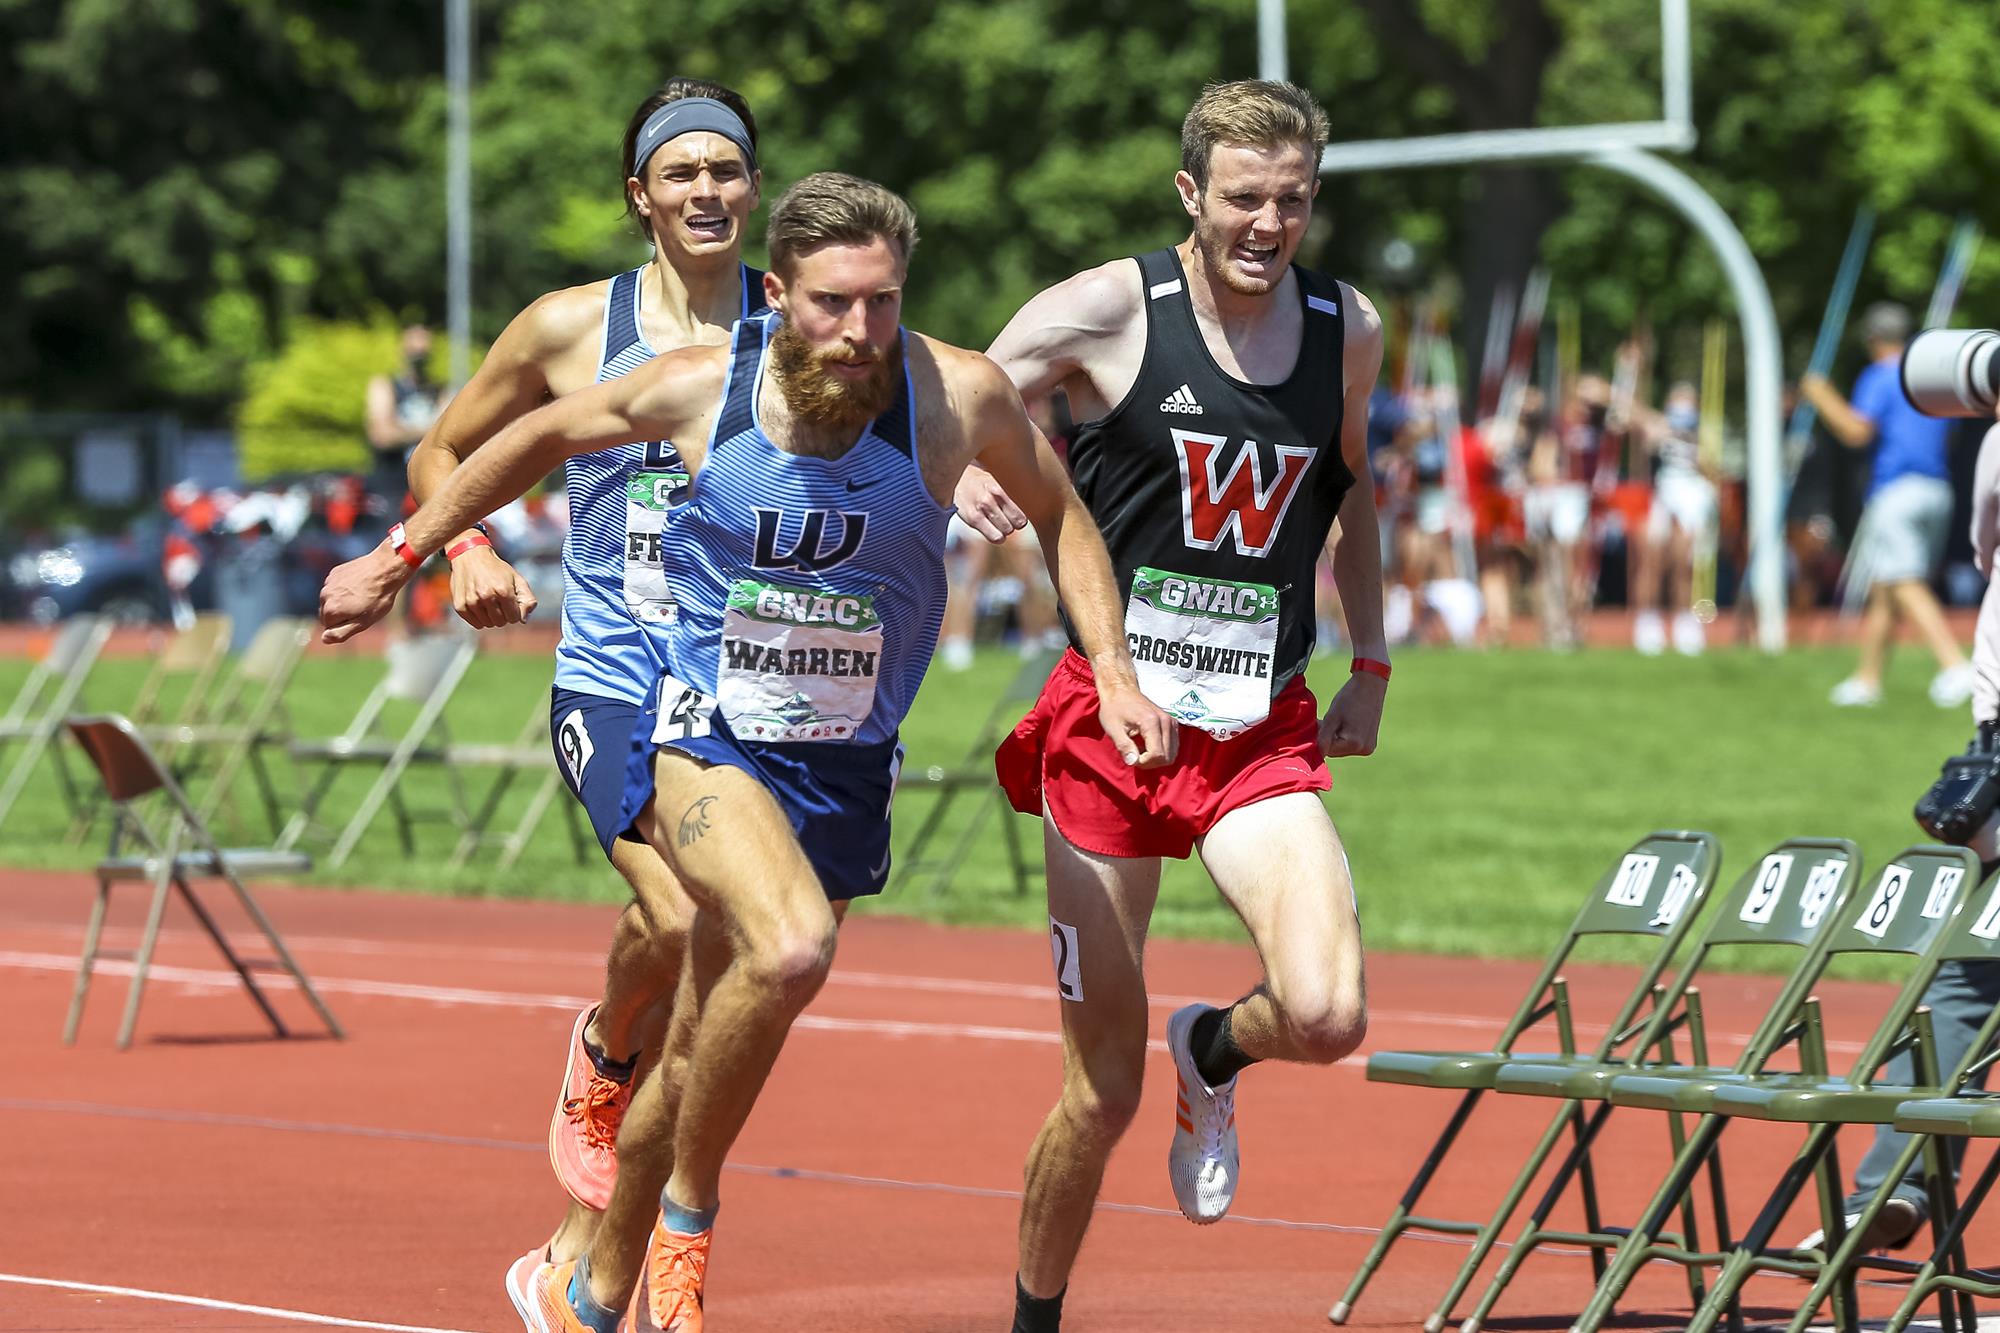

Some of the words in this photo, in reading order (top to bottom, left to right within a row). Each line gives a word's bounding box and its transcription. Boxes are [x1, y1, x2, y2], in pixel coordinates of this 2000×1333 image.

[1160, 400, 1204, 415] adidas
[1169, 427, 1318, 559] W
[756, 589, 860, 626] GNAC
[1160, 577, 1258, 617] GNAC
[725, 640, 877, 677] WARREN
[1126, 632, 1270, 679] CROSSWHITE
[668, 686, 702, 738] 4
[561, 723, 583, 777] 9
[1620, 860, 1649, 900] 10
[1752, 862, 1780, 914] 9
[1870, 874, 1901, 929] 8
[1052, 923, 1074, 997] 2
